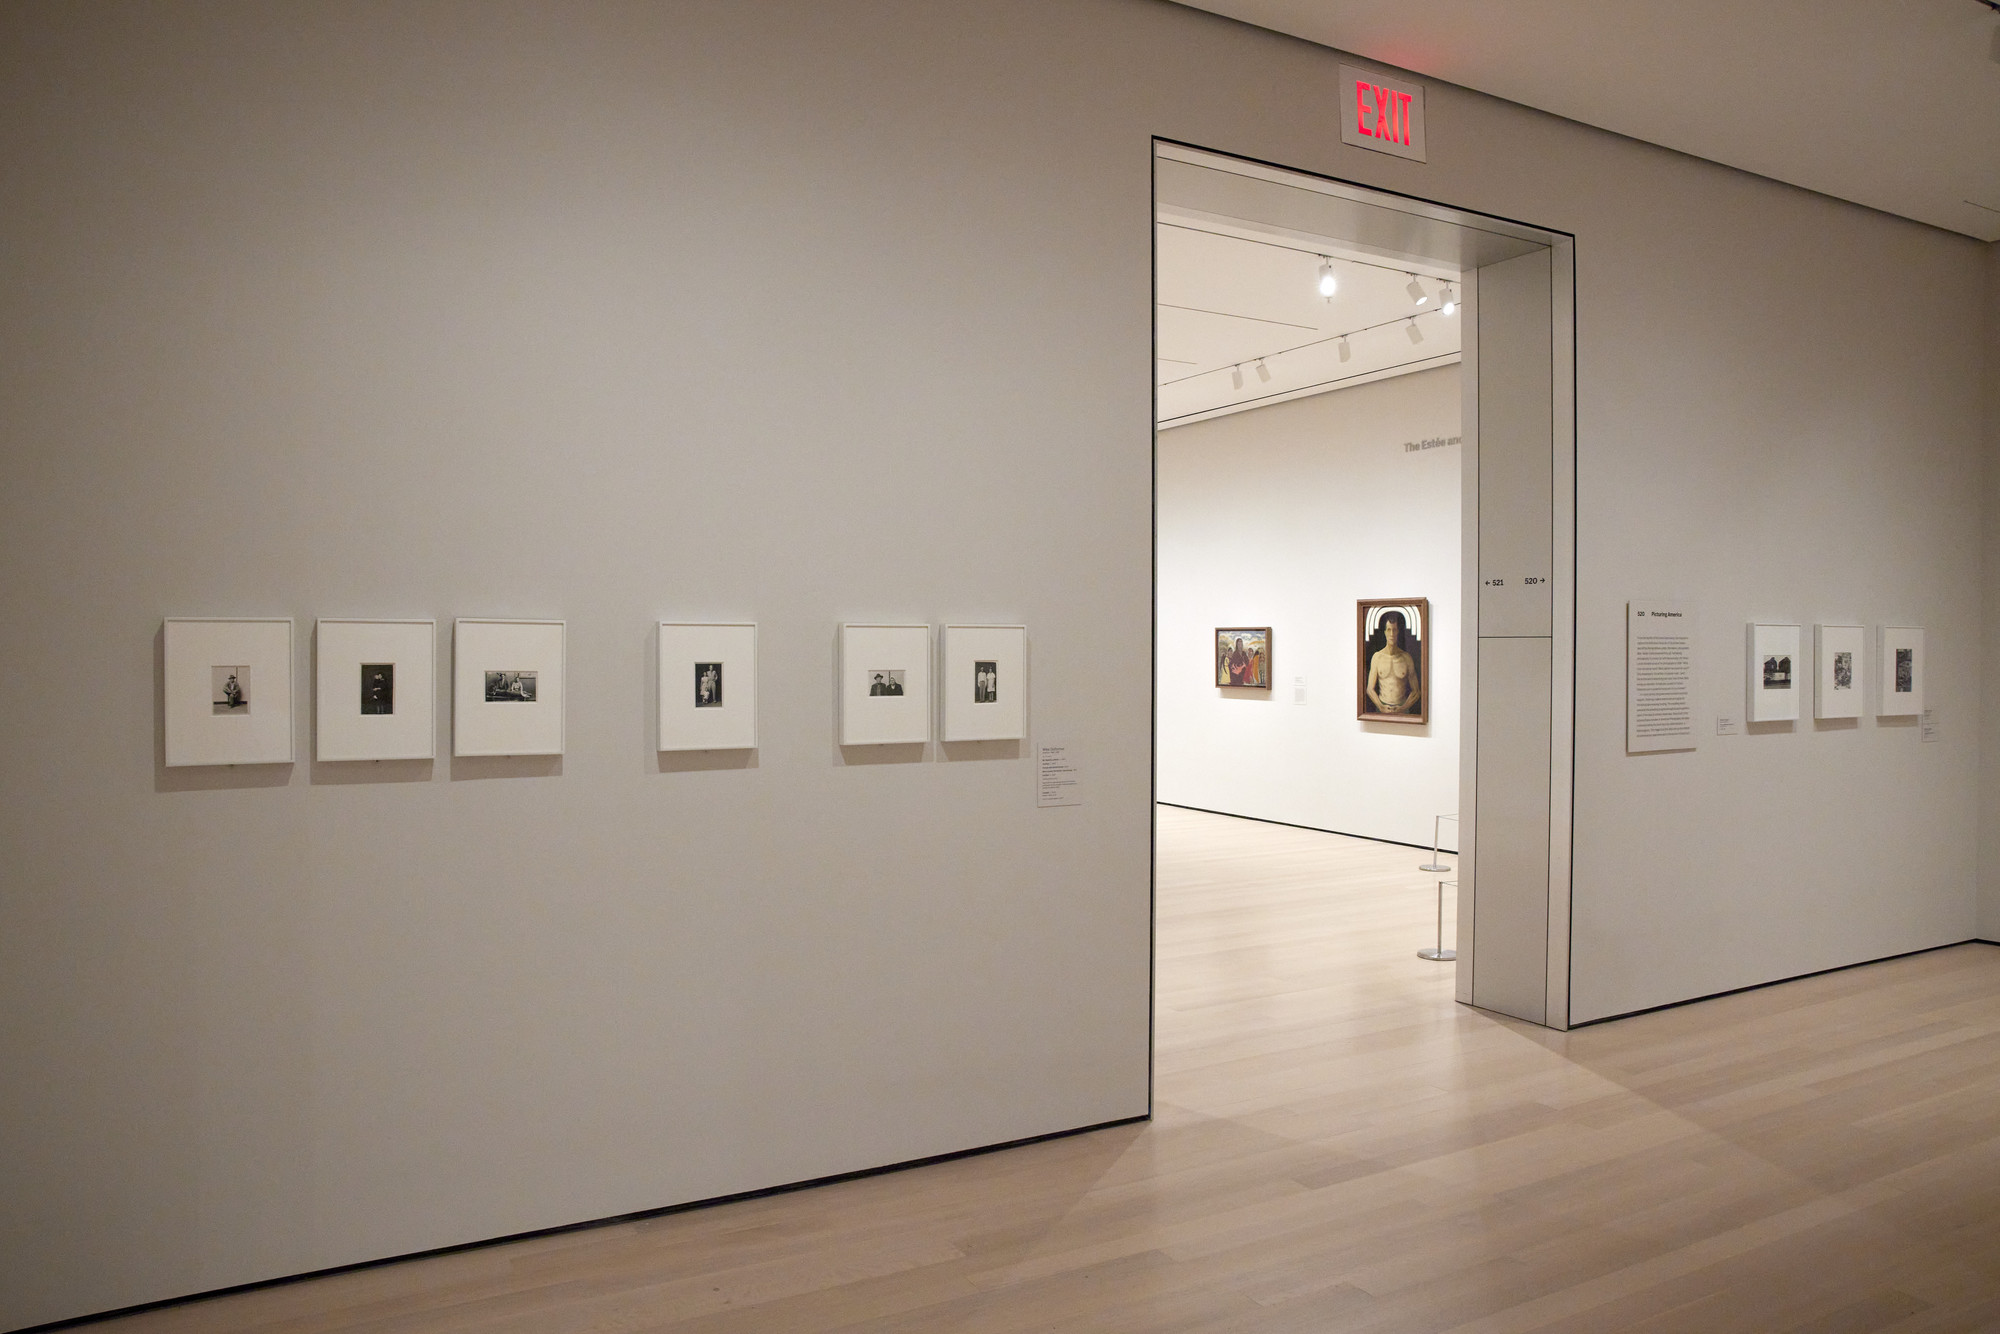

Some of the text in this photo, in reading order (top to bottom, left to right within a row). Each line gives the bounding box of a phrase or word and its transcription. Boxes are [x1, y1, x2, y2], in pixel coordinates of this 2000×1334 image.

[1356, 80, 1412, 147] EXIT
[1403, 442, 1420, 452] The
[1524, 577, 1538, 585] 520
